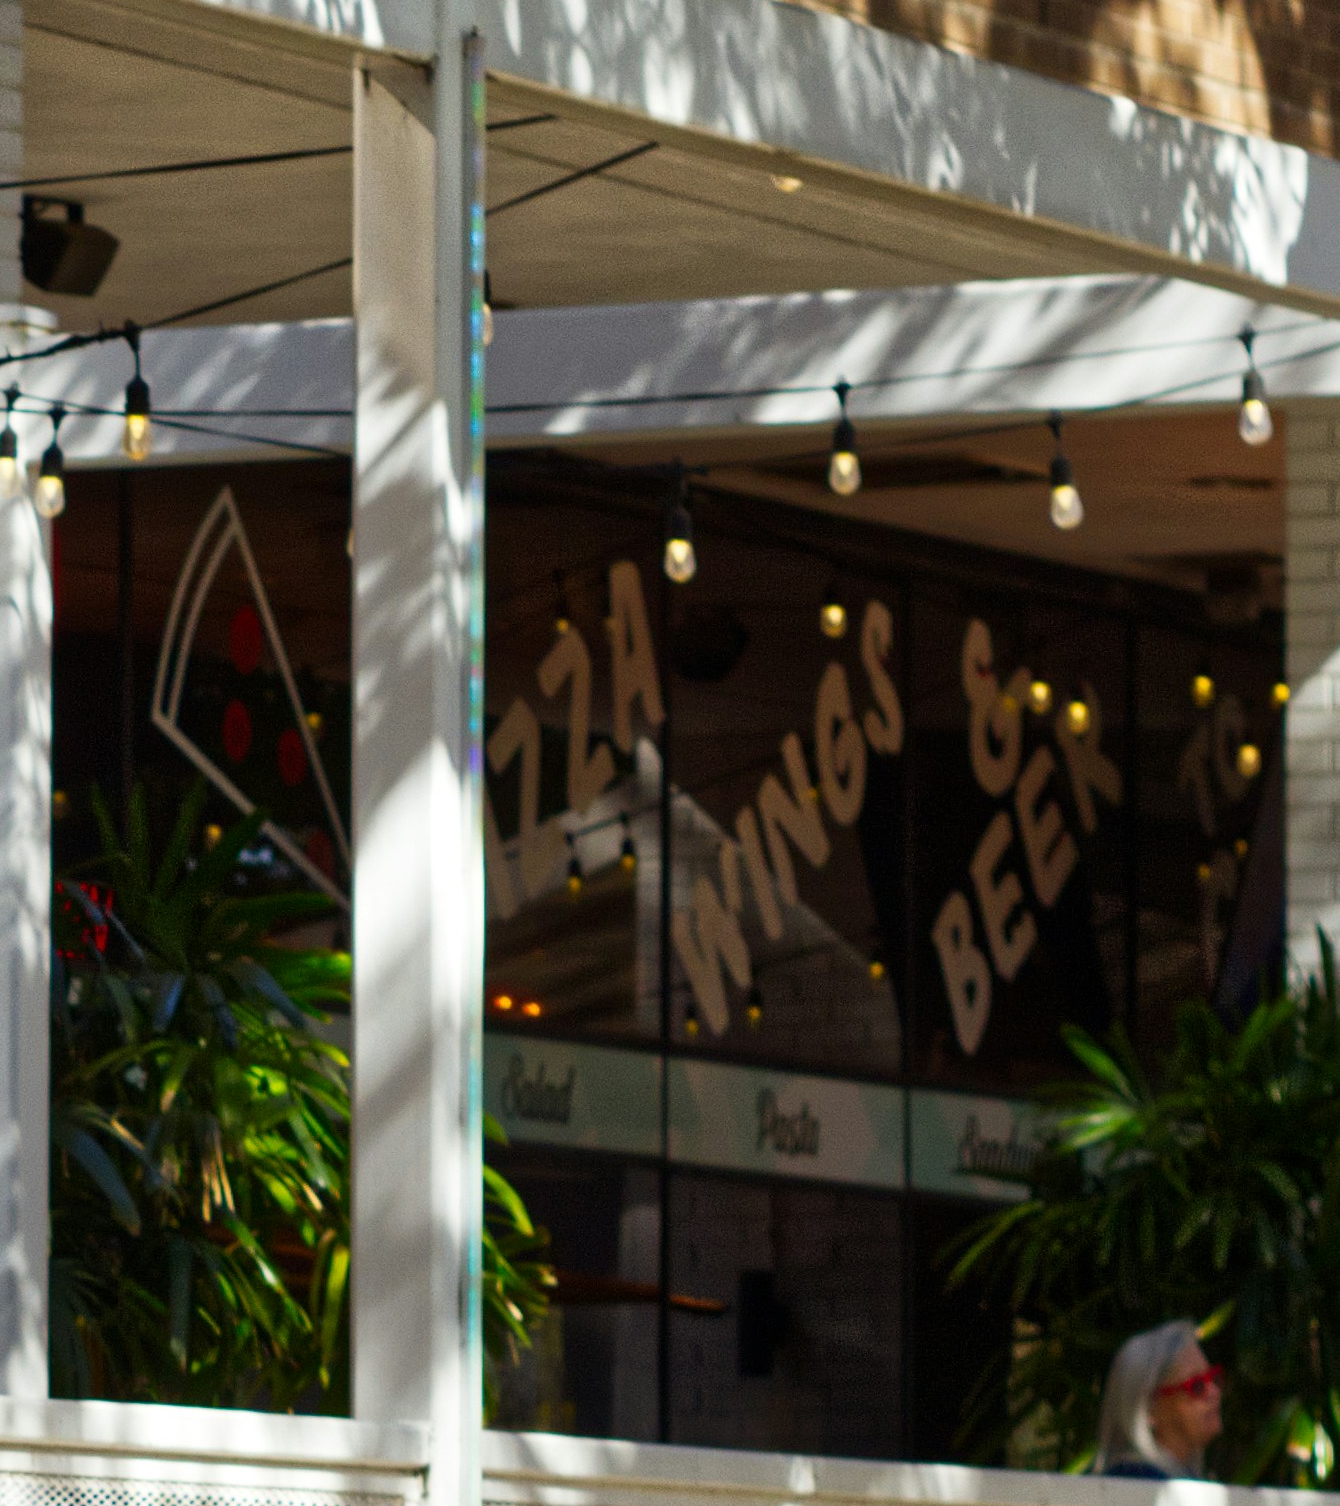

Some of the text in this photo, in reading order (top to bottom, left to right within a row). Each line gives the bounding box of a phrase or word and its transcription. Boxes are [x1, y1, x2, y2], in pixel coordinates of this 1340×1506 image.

[671, 596, 906, 1038] WINGS
[931, 678, 1124, 1057] BEER
[754, 1087, 819, 1159] Pasta
